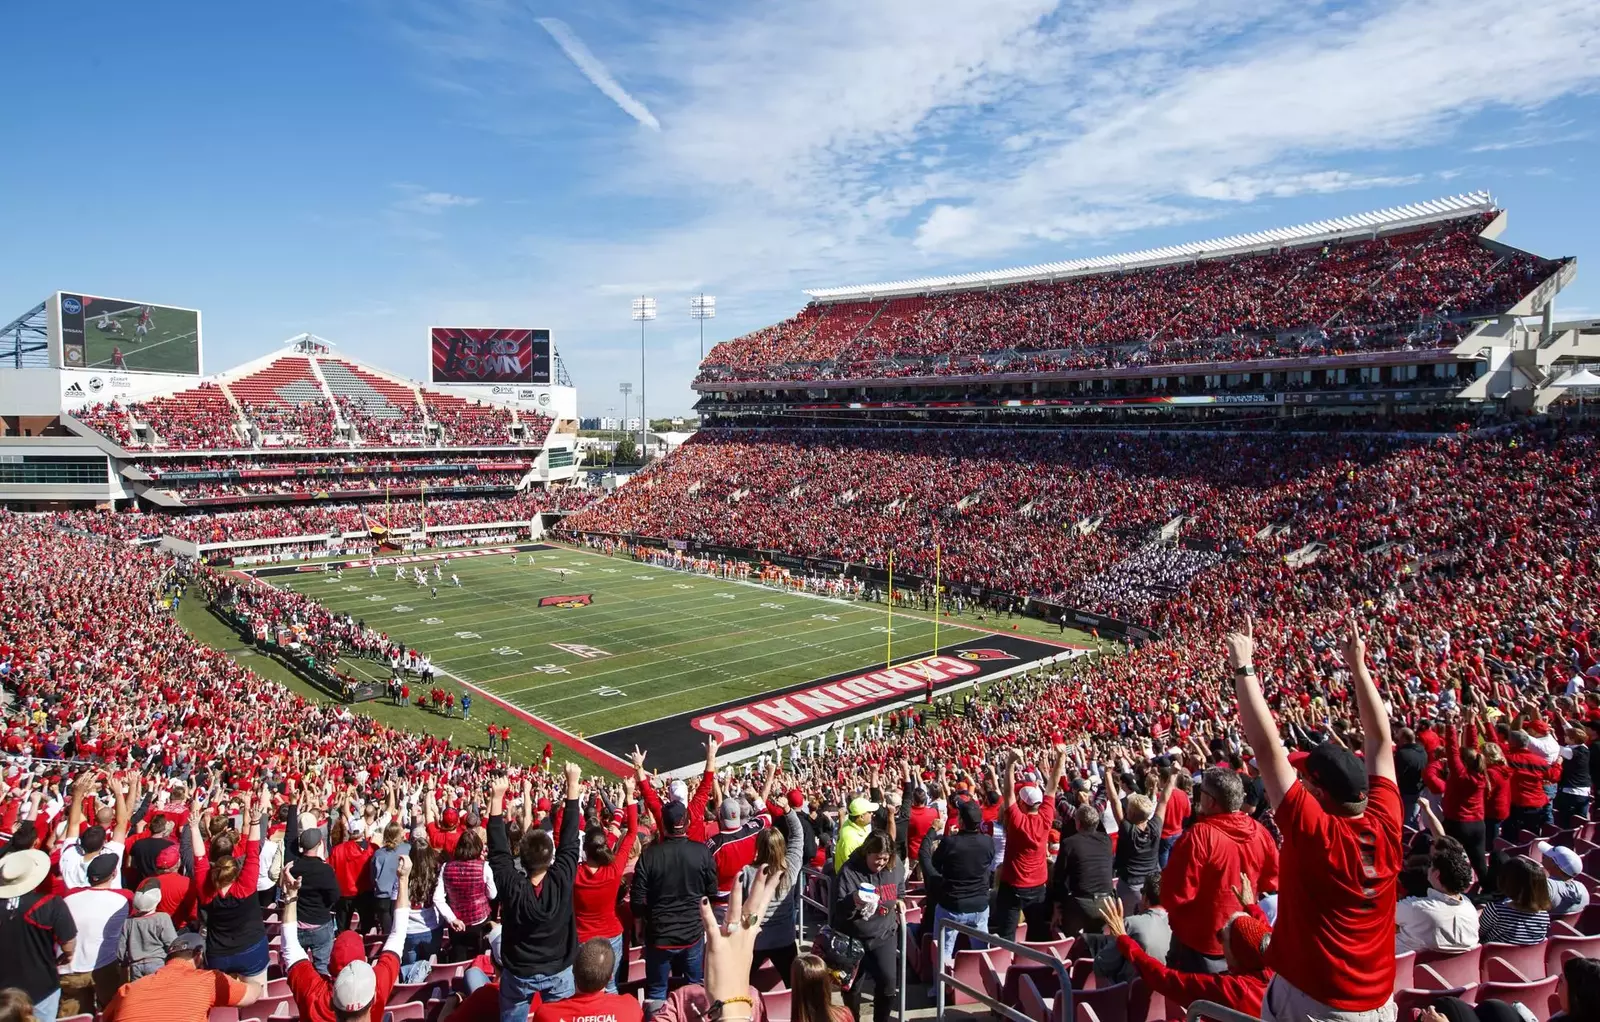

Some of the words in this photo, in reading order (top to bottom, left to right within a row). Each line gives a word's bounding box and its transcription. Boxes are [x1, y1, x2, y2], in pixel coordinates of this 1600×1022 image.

[446, 338, 520, 355] THIRD
[533, 664, 567, 675] 20
[590, 685, 622, 697] 10
[691, 656, 980, 745] CARDINALS
[577, 1014, 617, 1022] OFFICIAL
